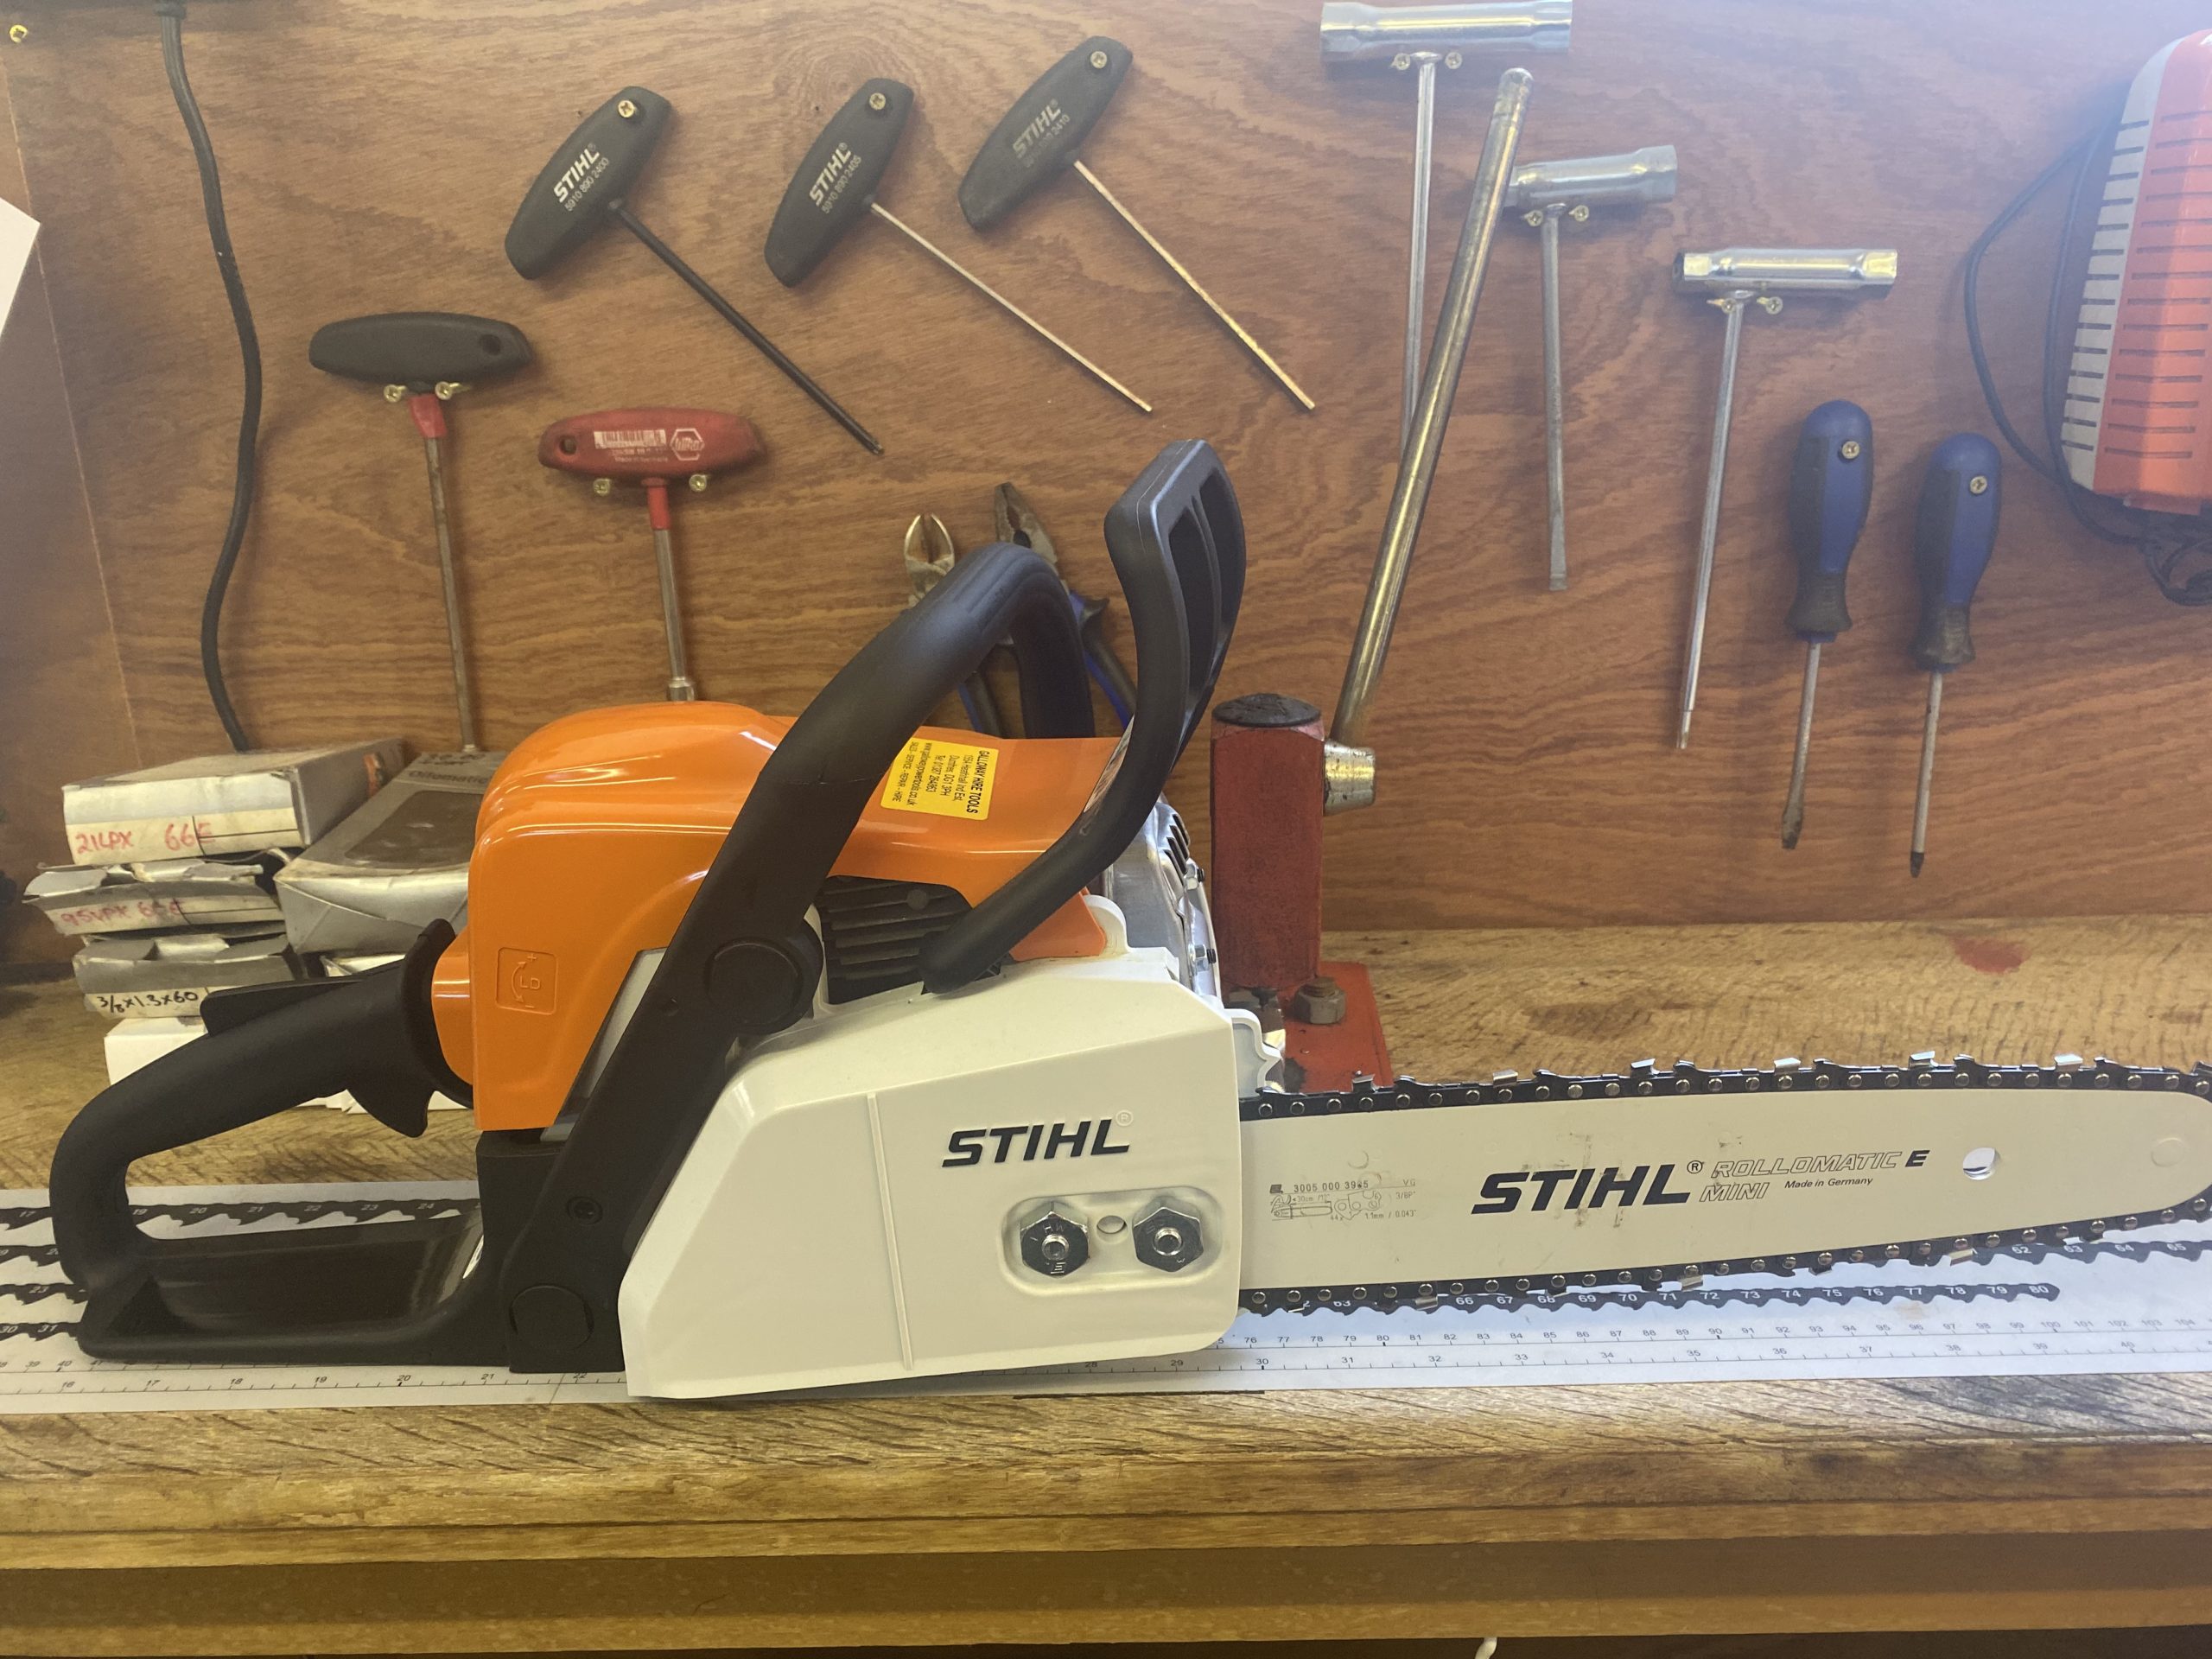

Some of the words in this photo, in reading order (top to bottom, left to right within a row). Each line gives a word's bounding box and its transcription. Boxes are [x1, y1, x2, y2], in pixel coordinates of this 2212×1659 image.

[1013, 105, 1061, 159] STIHL
[553, 148, 600, 203] STIHL
[810, 149, 851, 207] STIHL
[564, 191, 582, 212] 5910
[974, 751, 990, 777] GALLOWAY
[943, 773, 955, 785] DG1
[971, 777, 983, 791] HIRE
[893, 791, 903, 802] HIRE
[940, 785, 952, 796] 3PH
[967, 791, 982, 813] TOOLS
[942, 1118, 1131, 1168] STIHL
[1711, 1151, 1903, 1179] ROLLOMATIC
[1904, 1149, 1931, 1168] E
[1294, 1183, 1318, 1193] 3005
[1322, 1181, 1340, 1191] 000
[1471, 1163, 1691, 1215] STIHL
[1699, 1183, 1770, 1203] MINI
[1784, 1179, 1813, 1189] Made
[1827, 1177, 1873, 1187] Germany
[2012, 1246, 2031, 1255] 62
[2063, 1244, 2083, 1253] 63
[2114, 1244, 2134, 1253] 64
[2167, 1243, 2186, 1251] 65
[1455, 1296, 1474, 1306] 66
[1497, 1296, 1514, 1305] 67
[1537, 1294, 1555, 1305] 68
[1578, 1294, 1597, 1303] 69
[1618, 1294, 1637, 1302] 70
[1659, 1293, 1678, 1301] 71
[1700, 1291, 1720, 1300] 72
[1740, 1291, 1761, 1300] 73
[1782, 1289, 1801, 1298] 74
[1822, 1288, 1842, 1297] 75
[1863, 1287, 1884, 1296] 76
[1946, 1286, 1967, 1294] 78
[1986, 1286, 2008, 1294] 79
[2029, 1285, 2050, 1294] 80
[2039, 1320, 2062, 1329] 100
[2141, 1319, 2162, 1327] 103
[1170, 1358, 1184, 1367] 29
[396, 1374, 411, 1382] 20
